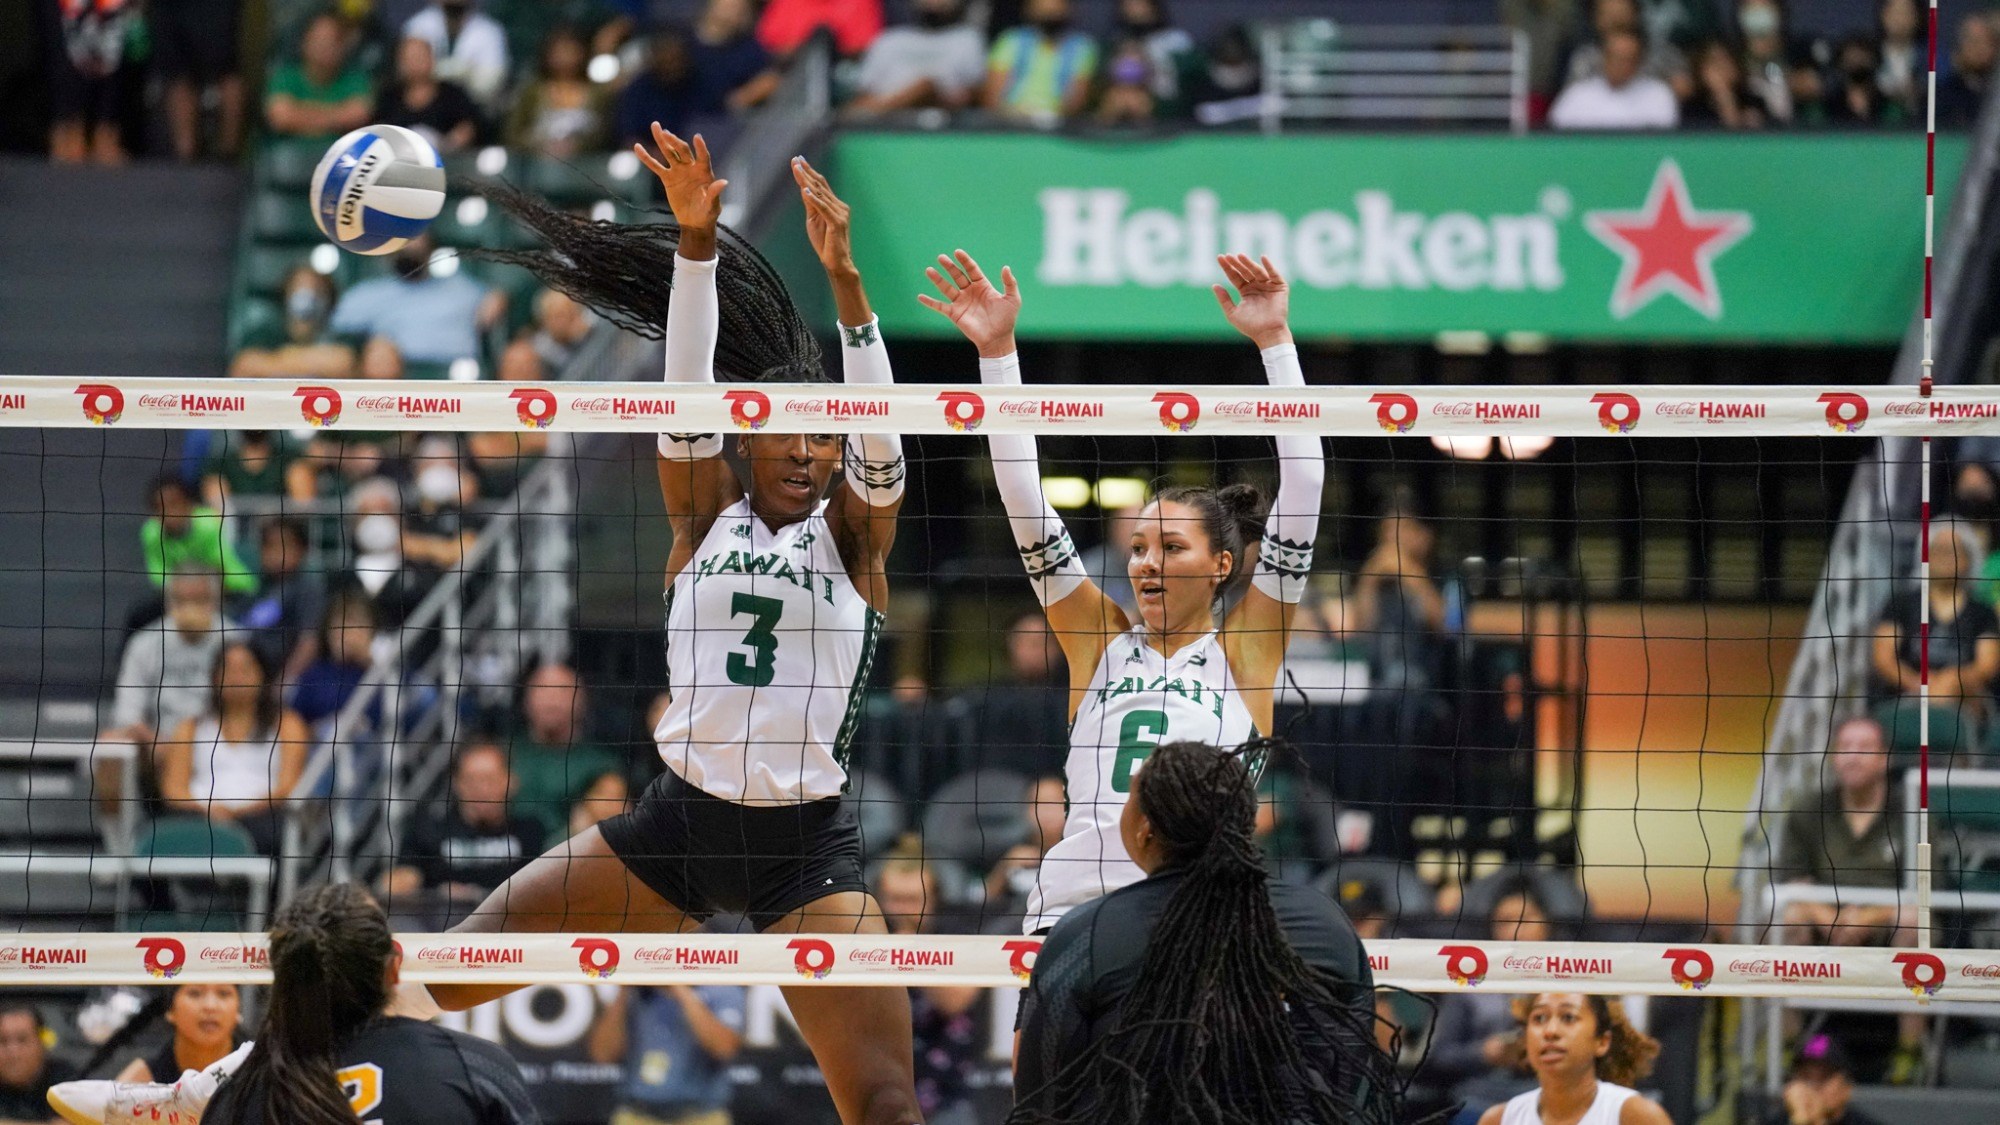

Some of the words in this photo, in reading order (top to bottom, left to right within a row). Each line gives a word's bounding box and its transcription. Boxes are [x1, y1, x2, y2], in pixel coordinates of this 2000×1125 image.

[340, 154, 378, 226] molten
[1038, 186, 1565, 291] Heineken
[181, 395, 244, 411] HAWAII
[398, 397, 460, 412] HAWAII
[613, 398, 675, 414] HAWAII
[827, 400, 888, 415] HAWAII
[1041, 401, 1103, 416] HAWAII
[1257, 402, 1319, 417] HAWAII
[1476, 402, 1539, 418] HAWAII
[1700, 402, 1765, 418] HAWAII
[1930, 402, 1997, 417] HAWAII
[726, 591, 784, 687] 3
[1111, 709, 1169, 793] 6
[22, 948, 86, 963] HAWAII
[460, 948, 522, 963] HAWAII
[676, 948, 738, 964] HAWAII
[891, 949, 953, 965] HAWAII
[1546, 957, 1611, 973] HAWAII
[1774, 961, 1840, 977] HAWAII
